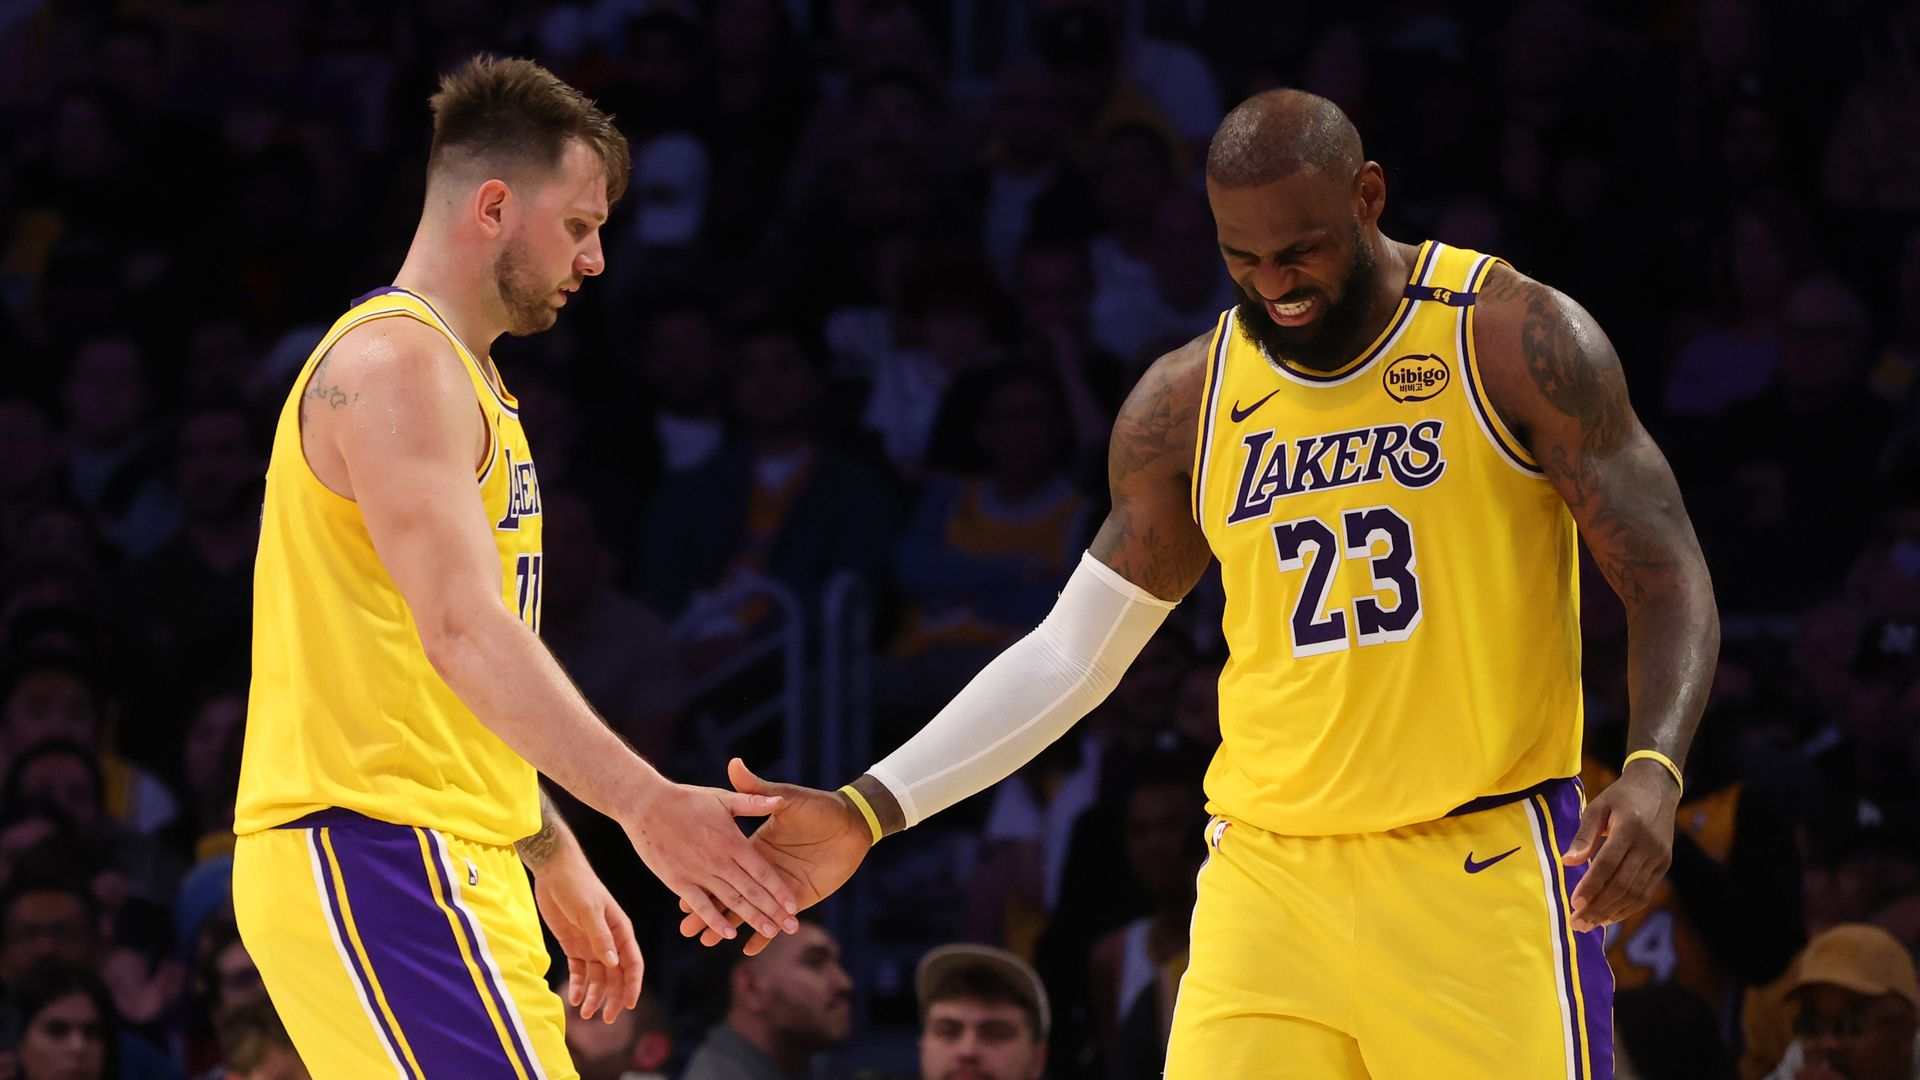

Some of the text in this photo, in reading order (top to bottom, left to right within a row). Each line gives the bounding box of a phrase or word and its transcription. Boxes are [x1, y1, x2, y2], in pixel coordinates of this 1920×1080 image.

[1432, 288, 1452, 303] 44
[1389, 366, 1446, 387] bibigo
[1399, 383, 1424, 393] 비비고
[1226, 418, 1448, 527] LAKERS
[1270, 504, 1423, 658] 23
